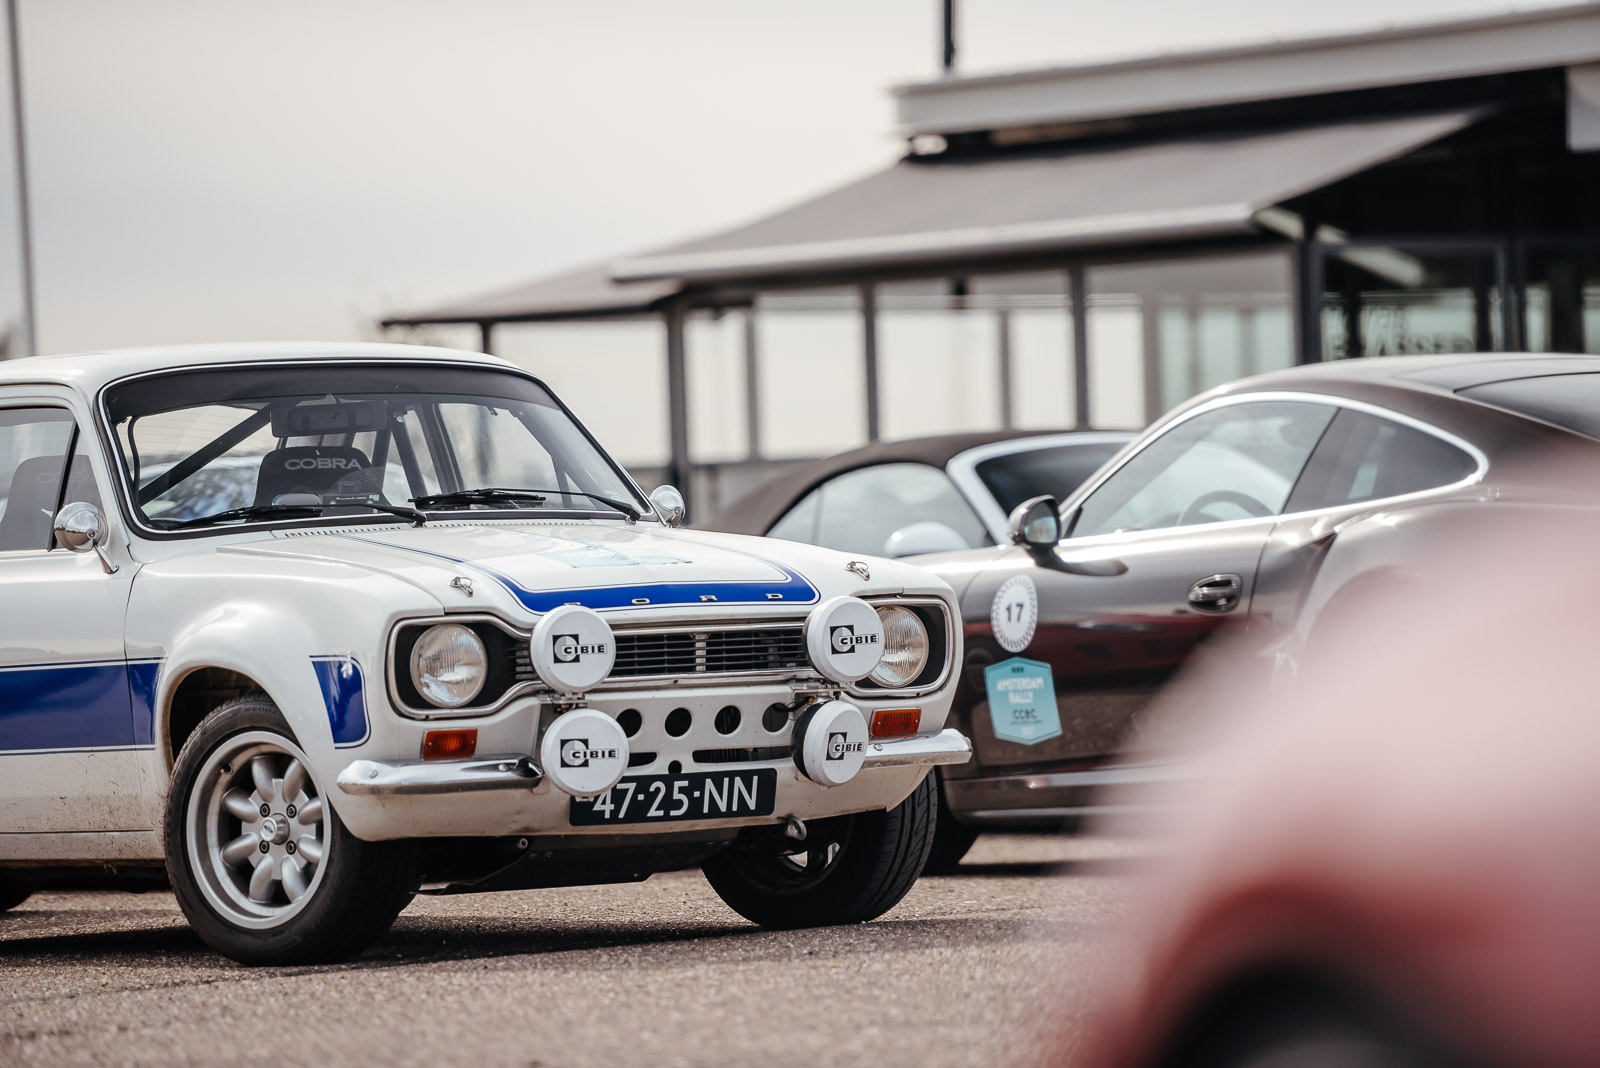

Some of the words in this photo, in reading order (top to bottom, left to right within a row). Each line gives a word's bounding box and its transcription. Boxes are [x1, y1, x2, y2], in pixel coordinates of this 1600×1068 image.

[284, 458, 362, 471] COBRA
[564, 592, 784, 606] ORD
[1005, 602, 1025, 623] 17
[996, 677, 1045, 691] AMSTERDAM
[1008, 690, 1034, 704] RALLY
[592, 775, 759, 819] 47-25-NN
